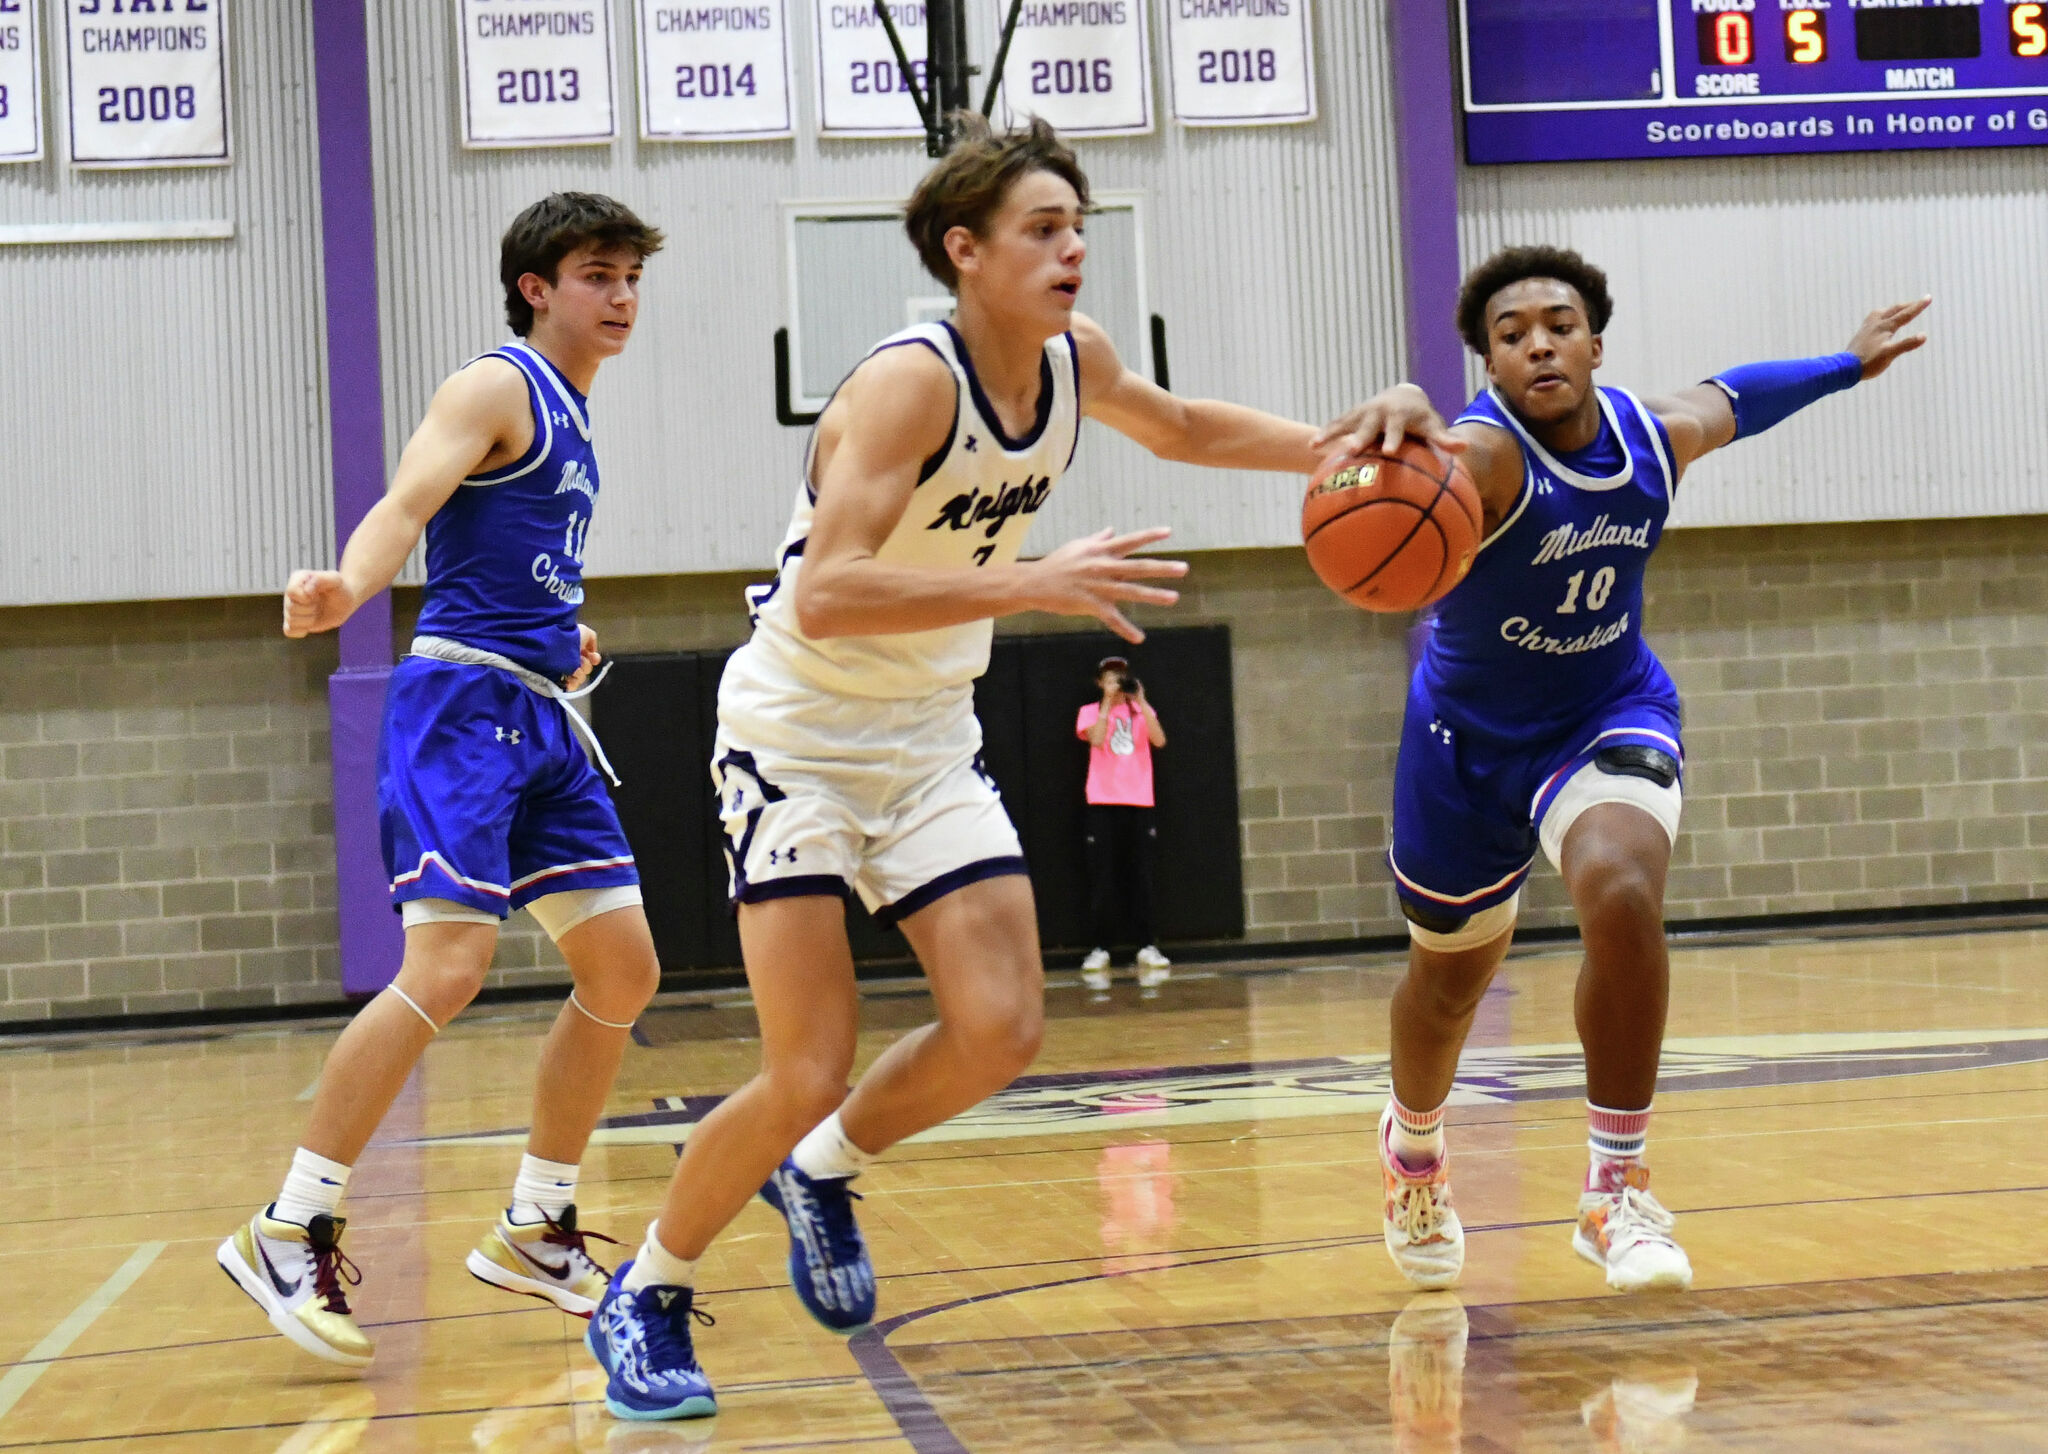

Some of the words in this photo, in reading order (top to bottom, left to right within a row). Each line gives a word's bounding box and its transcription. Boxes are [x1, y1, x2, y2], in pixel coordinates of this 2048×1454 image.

[477, 10, 595, 38] CHAMPIONS
[656, 7, 771, 32] CHAMPIONS
[1180, 0, 1290, 19] CHAMPIONS
[83, 26, 206, 52] CHAMPIONS
[1716, 11, 1750, 65] 0
[1787, 9, 1823, 64] 5
[676, 63, 757, 98] 2014
[1031, 58, 1112, 94] 2016
[1199, 48, 1276, 84] 2018
[1885, 67, 1955, 90] MATCH
[497, 68, 580, 104] 2013
[1695, 73, 1760, 97] SCORE
[99, 86, 196, 122] 2008
[1646, 116, 1834, 144] Scoreboards
[1846, 114, 1874, 135] In
[1886, 112, 1976, 135] Honor
[1987, 110, 2017, 132] of
[563, 510, 588, 565] 11
[1531, 513, 1652, 566] Midland
[1556, 565, 1617, 614] 10
[1500, 612, 1630, 656] Christian
